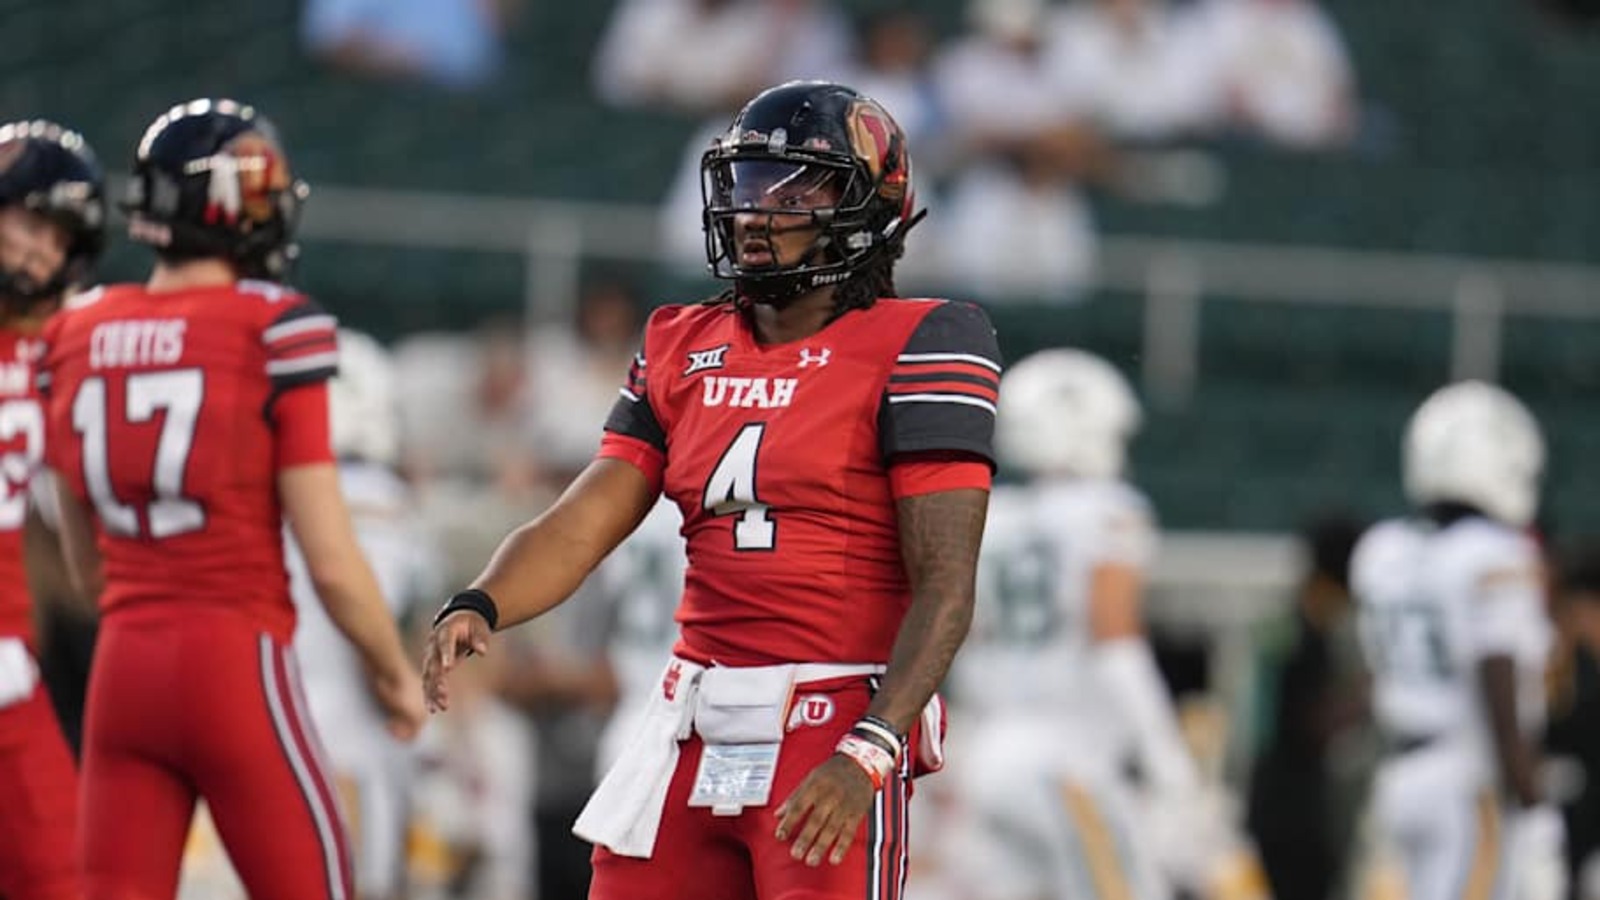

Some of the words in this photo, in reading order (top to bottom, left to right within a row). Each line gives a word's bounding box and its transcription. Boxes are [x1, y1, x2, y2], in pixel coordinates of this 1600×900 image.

[89, 318, 187, 368] CURTIS
[684, 345, 729, 376] XII
[703, 376, 798, 408] UTAH
[73, 368, 205, 538] 17
[702, 422, 777, 552] 4
[807, 700, 829, 720] U
